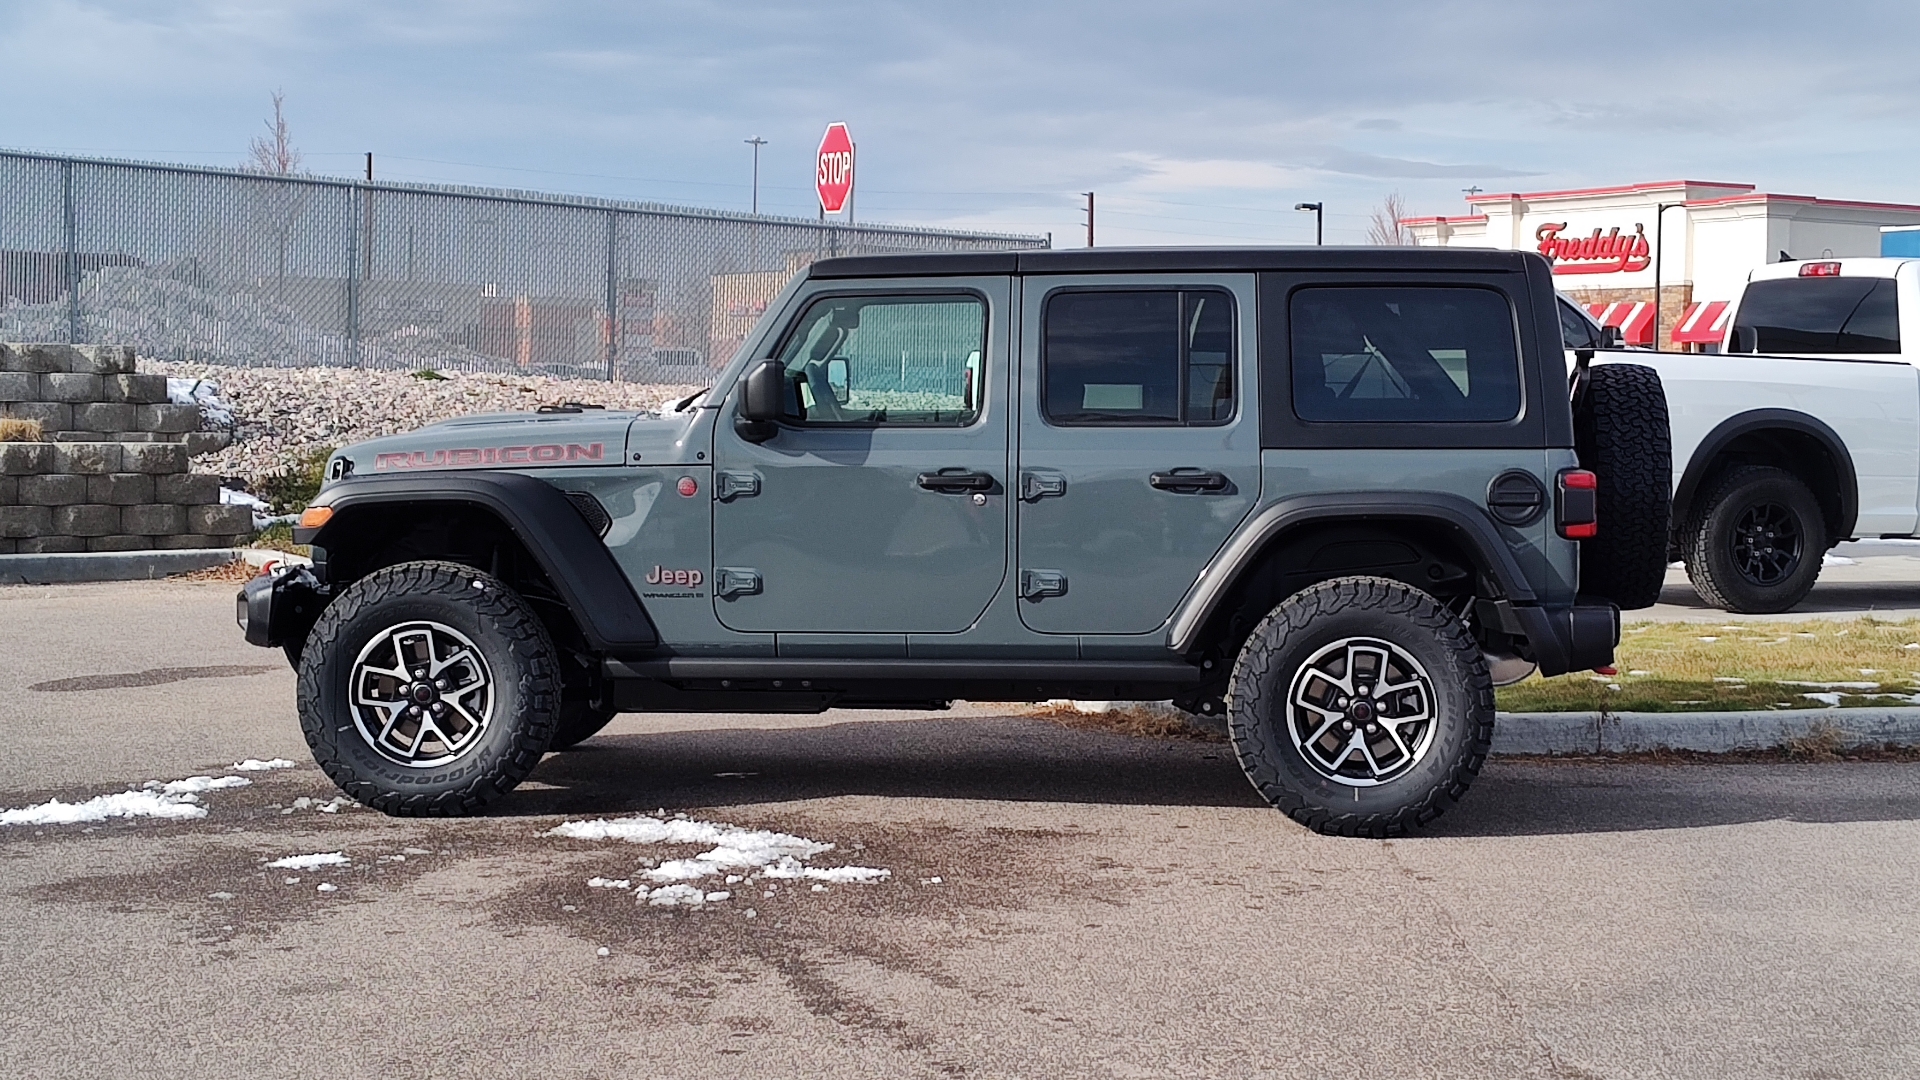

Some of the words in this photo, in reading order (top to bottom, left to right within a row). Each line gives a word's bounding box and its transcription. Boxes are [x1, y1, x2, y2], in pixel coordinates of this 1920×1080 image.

[819, 151, 851, 186] STOP
[1536, 222, 1651, 274] Freddy's
[374, 442, 604, 471] RUBICON
[645, 565, 703, 588] Jeep
